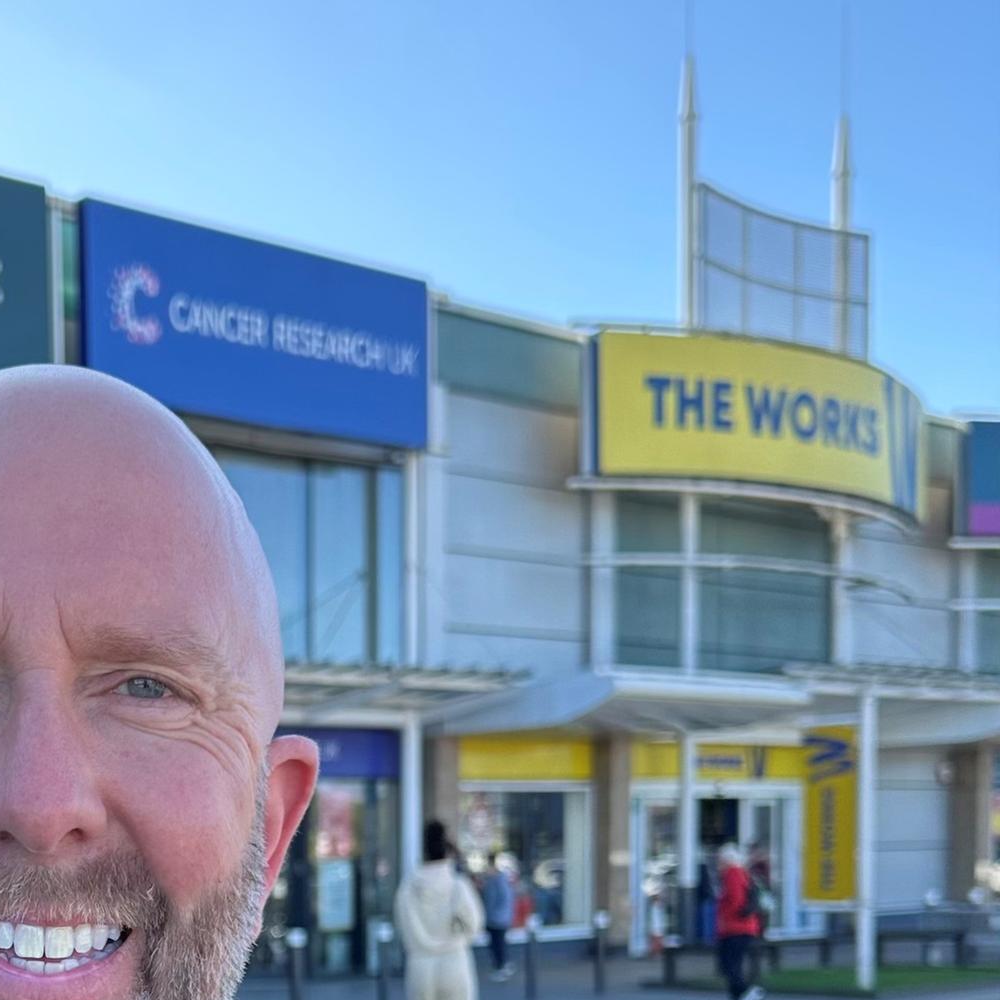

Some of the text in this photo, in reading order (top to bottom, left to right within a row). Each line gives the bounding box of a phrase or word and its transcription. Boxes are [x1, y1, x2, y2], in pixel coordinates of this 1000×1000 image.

[169, 294, 420, 376] CANCER RESEARCH UK
[644, 374, 880, 456] THE WORKS
